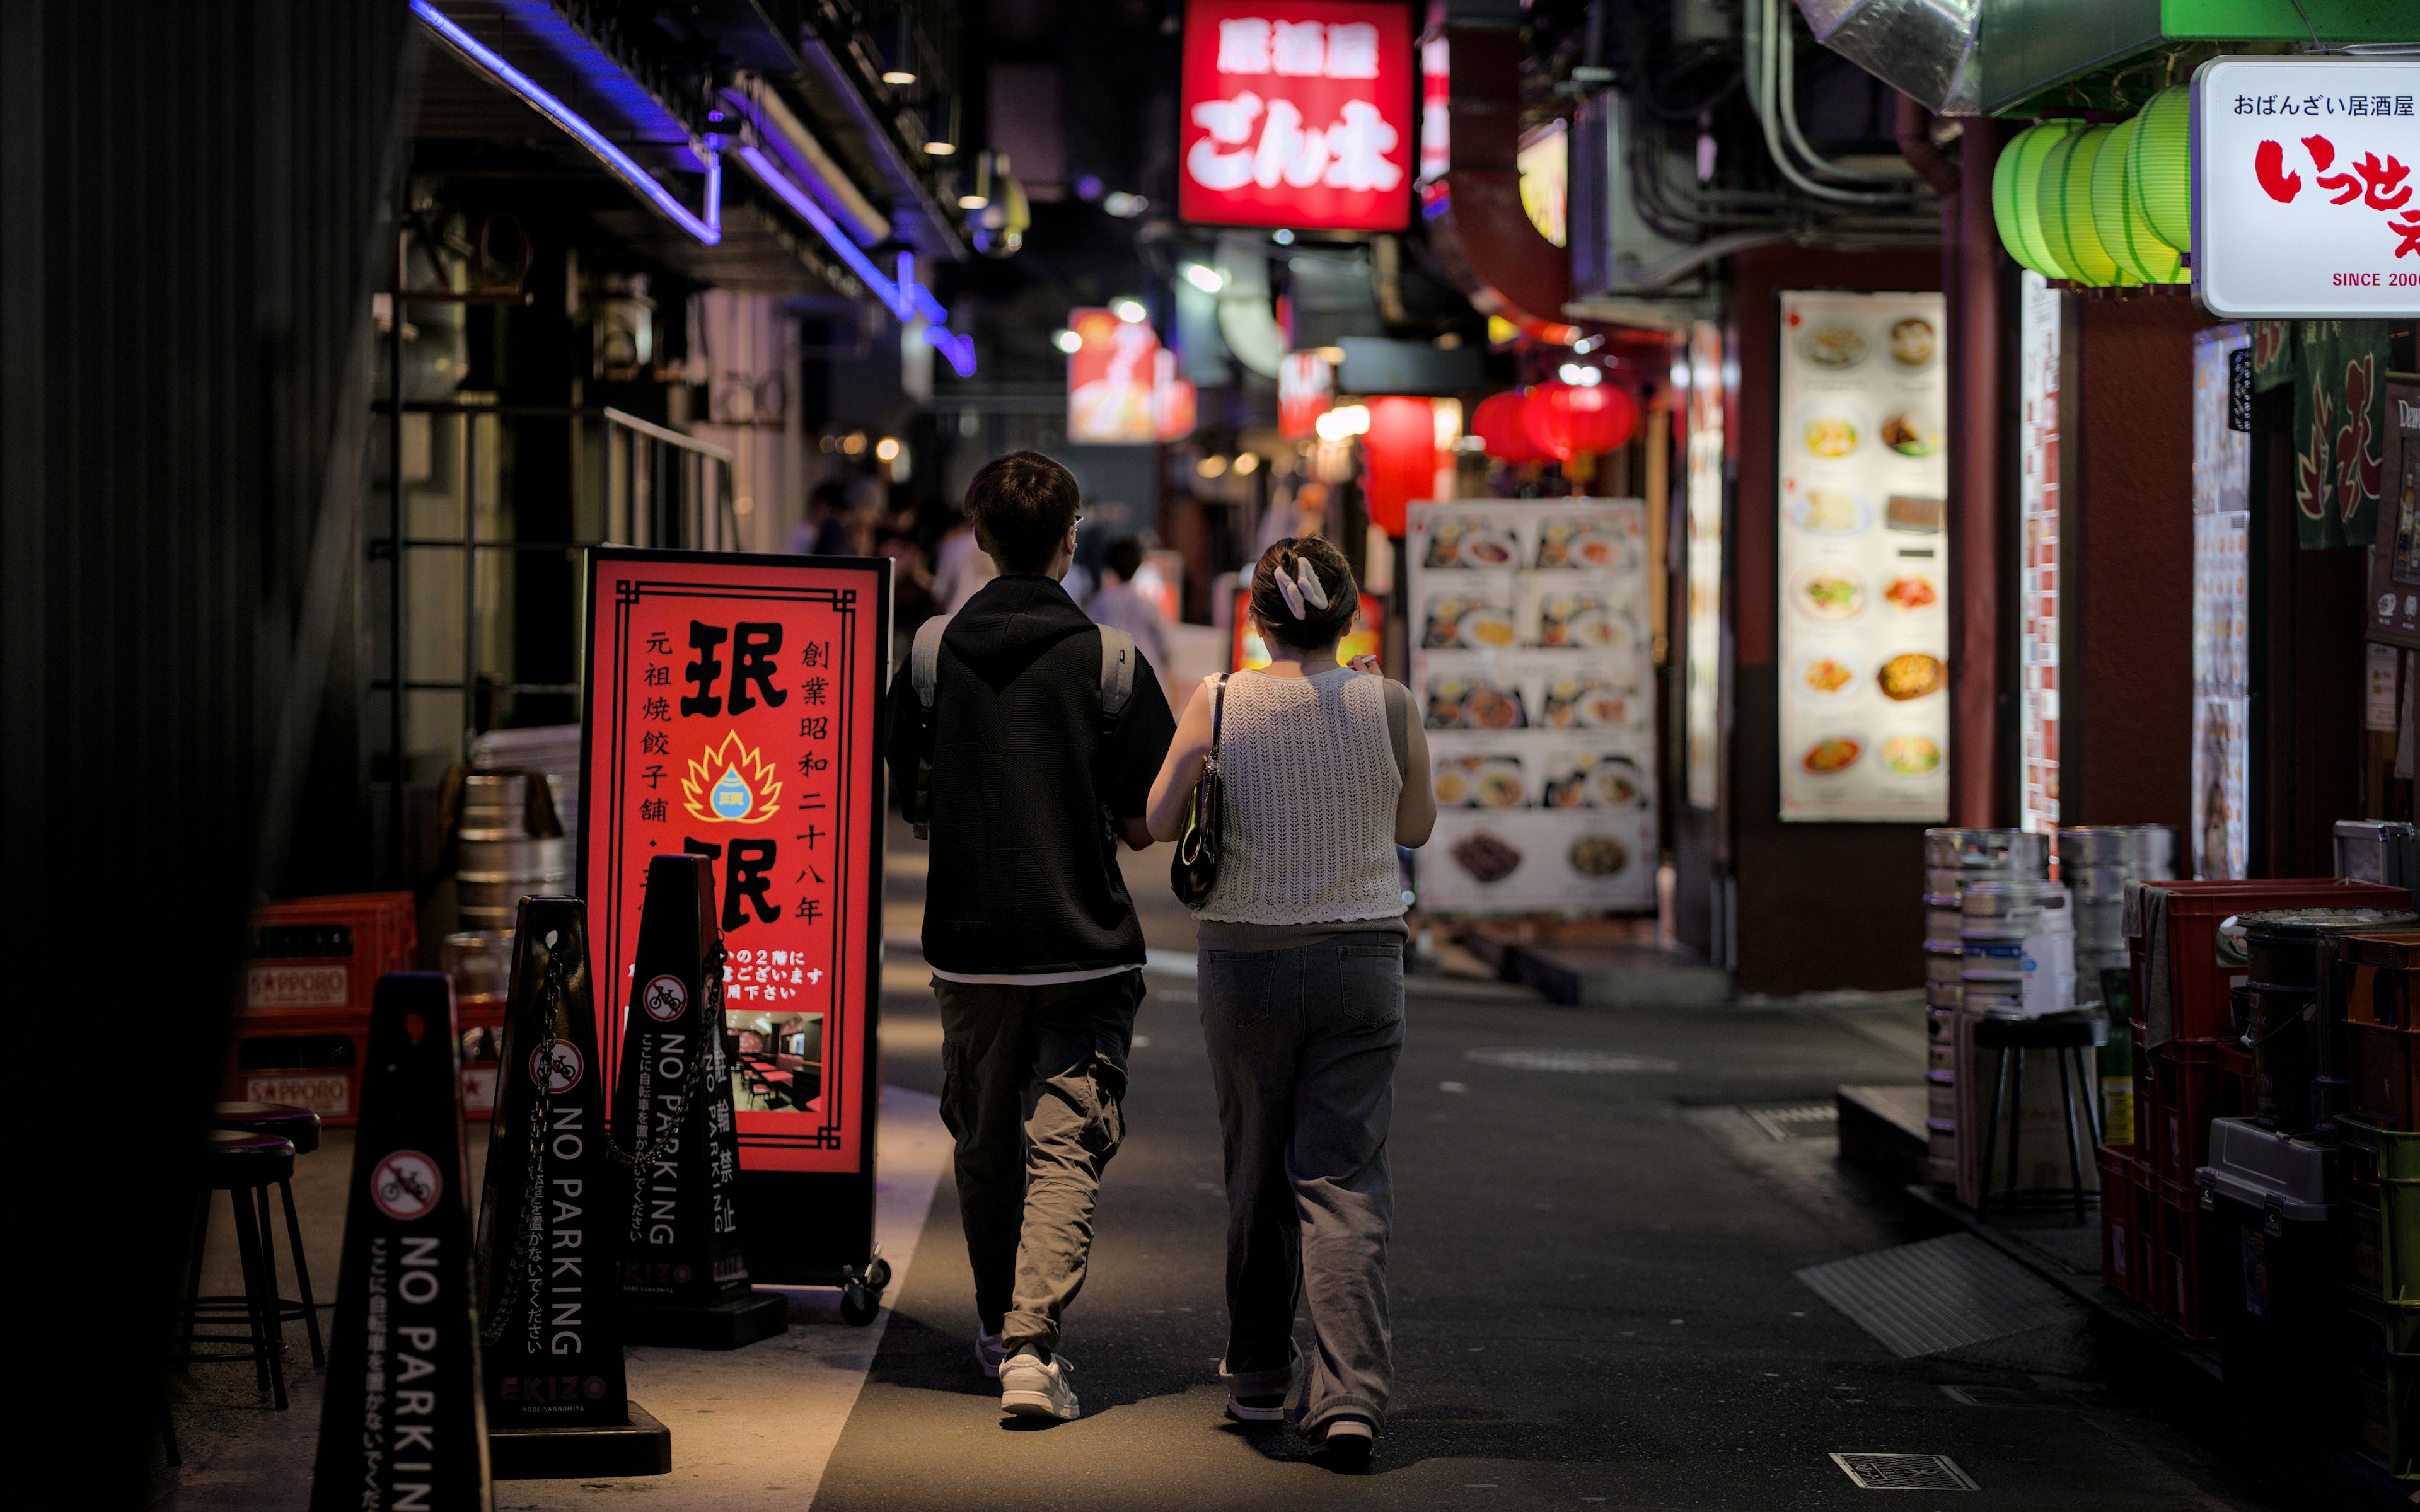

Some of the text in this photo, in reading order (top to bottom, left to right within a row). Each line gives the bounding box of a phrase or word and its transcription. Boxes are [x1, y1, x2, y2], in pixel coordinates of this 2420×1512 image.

[2233, 94, 2415, 117] おばんざい居酒屋
[2332, 273, 2380, 286] SINCE
[795, 640, 830, 926] 創業昭和二十八年
[551, 1107, 583, 1356] NO PARKING
[649, 1034, 685, 1245] NO PARKING
[705, 1053, 724, 1233] NO PARKING
[391, 1236, 441, 1512] NO PARKIN
